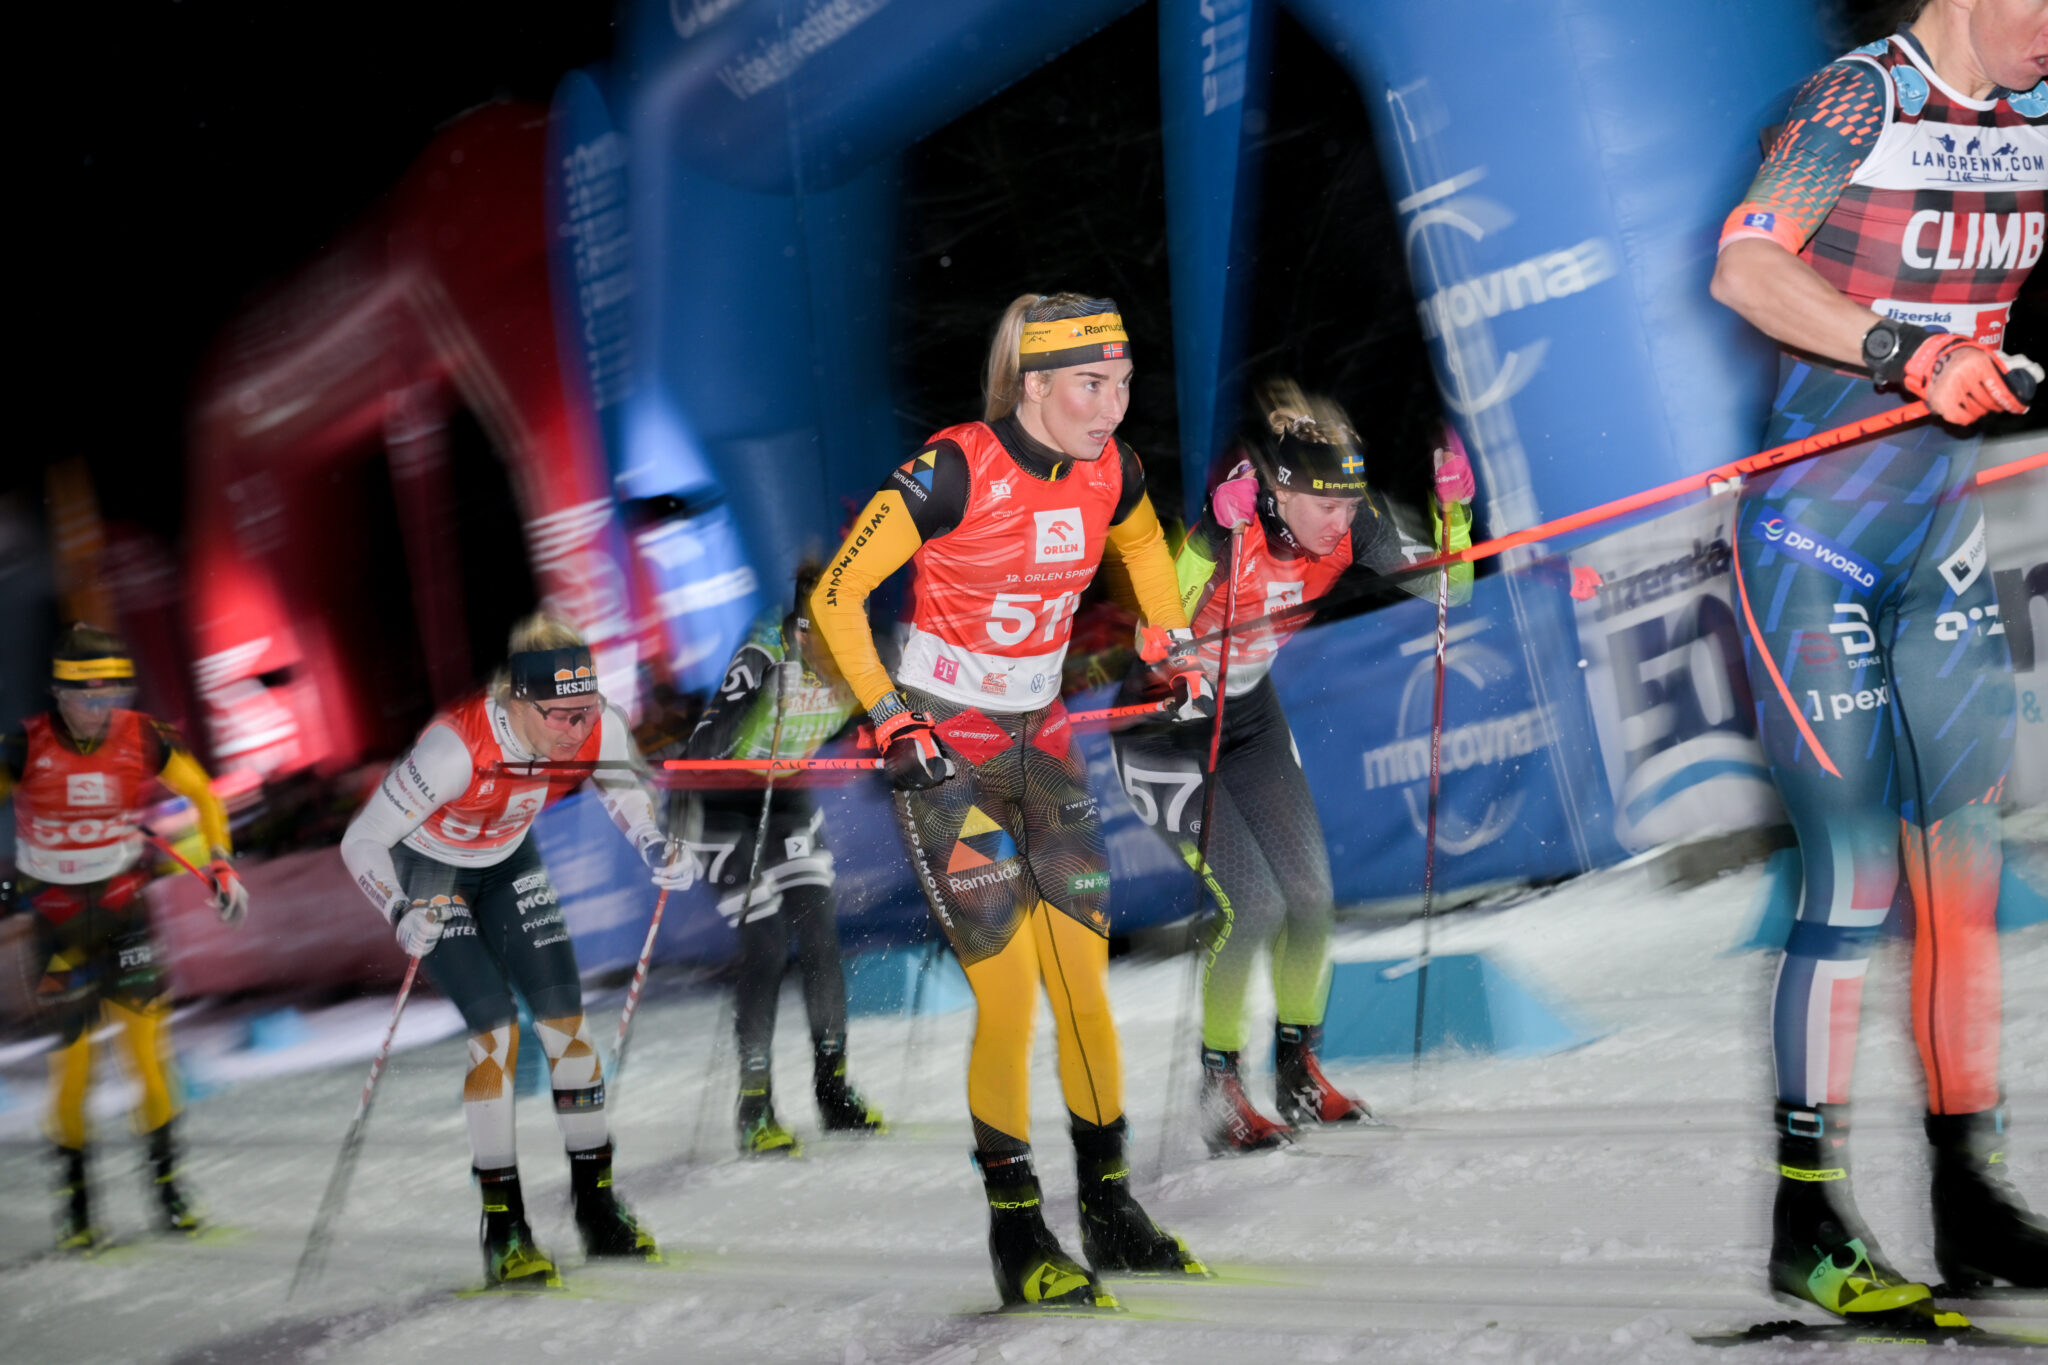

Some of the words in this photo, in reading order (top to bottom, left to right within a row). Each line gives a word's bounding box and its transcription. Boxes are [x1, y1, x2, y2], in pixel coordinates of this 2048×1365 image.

[1912, 148, 2045, 172] LANGRENN.COM
[1901, 208, 2046, 271] CLIMB
[1886, 308, 1952, 324] Jizerská
[826, 502, 891, 608] SWEDEMOUNT
[1043, 543, 1079, 556] ORLEN
[1783, 528, 1815, 551] DP
[1814, 547, 1876, 590] WORLD
[1024, 571, 1063, 583] ORLEN
[903, 791, 955, 929] SWEDEMOUNT
[990, 1198, 1040, 1209] FISCHER
